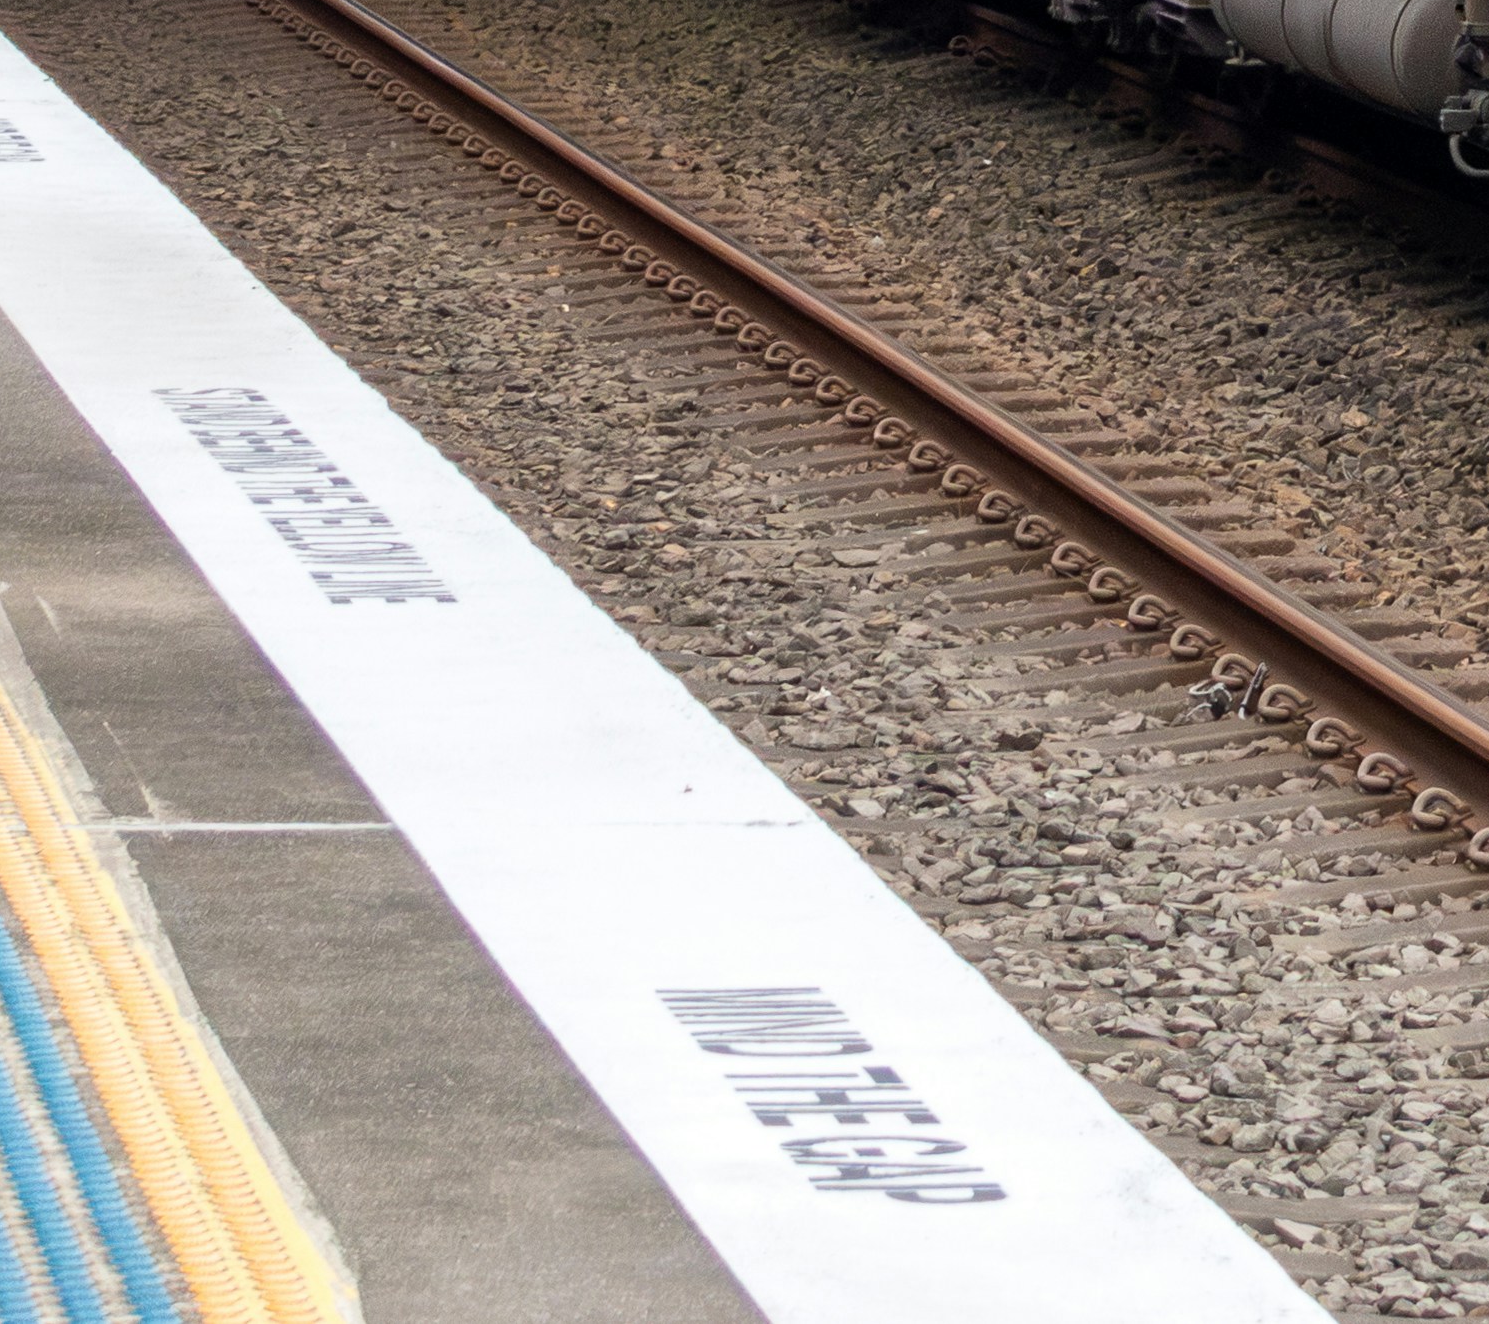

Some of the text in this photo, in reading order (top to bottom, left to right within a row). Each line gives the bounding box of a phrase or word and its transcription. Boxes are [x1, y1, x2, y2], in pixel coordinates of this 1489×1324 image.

[235, 475, 370, 505] THE
[260, 505, 429, 566] YELLOW
[309, 569, 459, 605] LINE
[654, 986, 1010, 1206] MIND THE GAP
